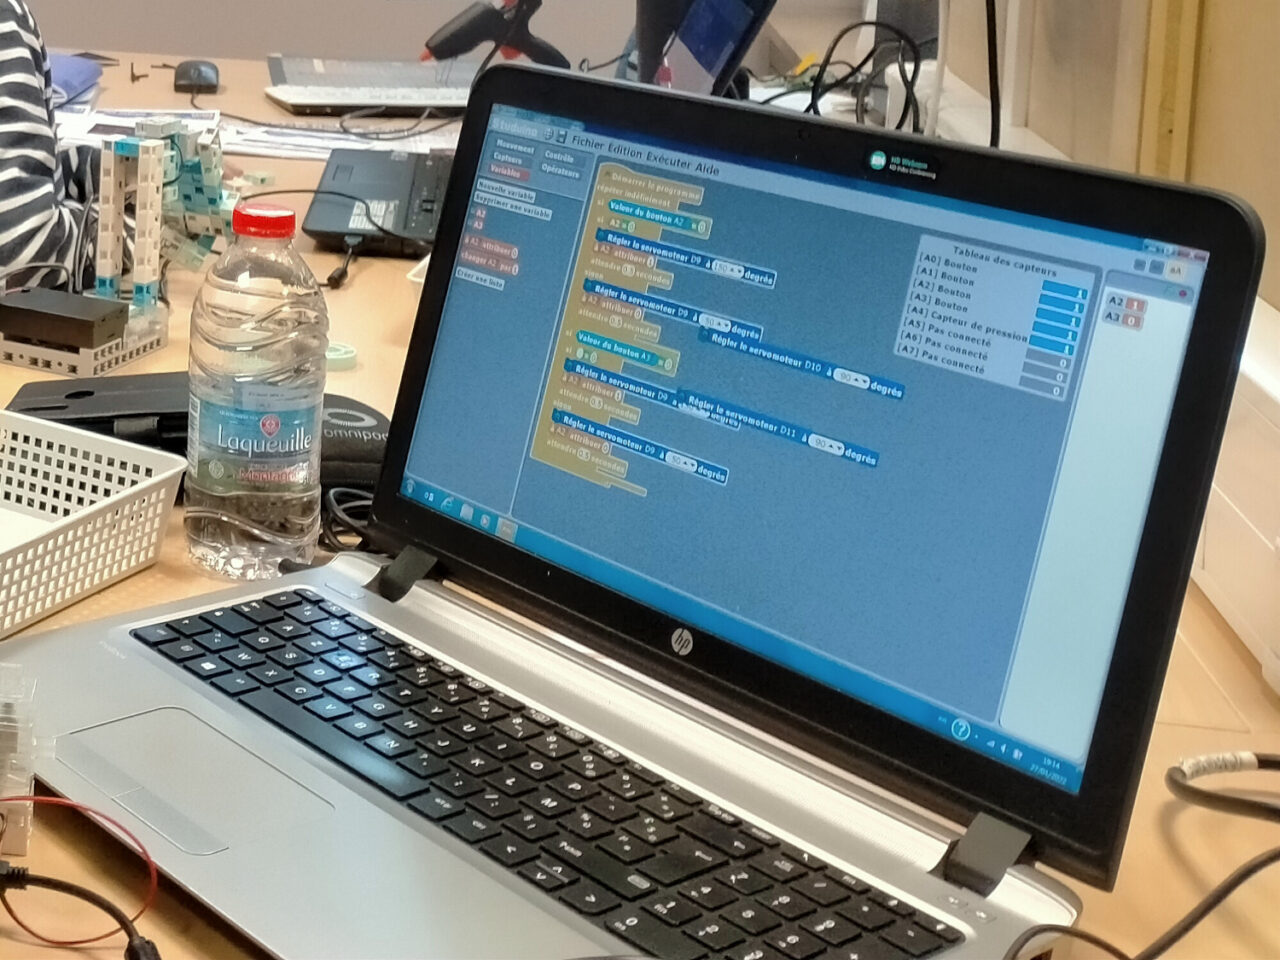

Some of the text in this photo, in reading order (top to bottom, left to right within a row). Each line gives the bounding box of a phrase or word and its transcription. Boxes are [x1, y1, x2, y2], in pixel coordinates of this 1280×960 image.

[572, 135, 605, 151] Fichier
[646, 150, 692, 170] Exécuter
[695, 162, 720, 177] Aide
[610, 200, 634, 215] Valeur
[646, 211, 672, 223] bouton
[607, 234, 631, 247] Régler
[641, 243, 689, 262] servomoteur
[744, 268, 774, 285] degrés
[944, 258, 978, 274] Bouton
[953, 245, 1057, 278] Tableau des capteurs
[937, 285, 971, 300] Bouton
[940, 271, 975, 287] Bouton
[594, 285, 618, 298] Régler
[628, 295, 676, 315] servomoteur
[934, 298, 969, 313] Bouton
[1109, 296, 1123, 306] A2
[931, 310, 968, 328] Capteur
[970, 322, 983, 332] de
[986, 325, 1029, 344] pression
[1105, 312, 1120, 322] A3
[925, 337, 942, 349] Pas
[944, 342, 989, 361] connecté
[928, 324, 945, 336] Pas
[948, 329, 992, 348] connecté
[711, 333, 738, 349] Régler
[749, 346, 803, 368] servomoteur
[871, 381, 903, 398] degrés
[922, 350, 939, 362] Pas
[941, 356, 985, 375] connecté
[575, 364, 599, 378] Régler
[608, 374, 656, 398] servomoteur
[218, 424, 312, 459] Laqueuille
[689, 395, 714, 412] Régler
[725, 407, 778, 432] servomoteur
[845, 448, 877, 466] degrés
[563, 416, 587, 431] Régler
[596, 427, 643, 451] servomoteur
[697, 465, 726, 481] degrés
